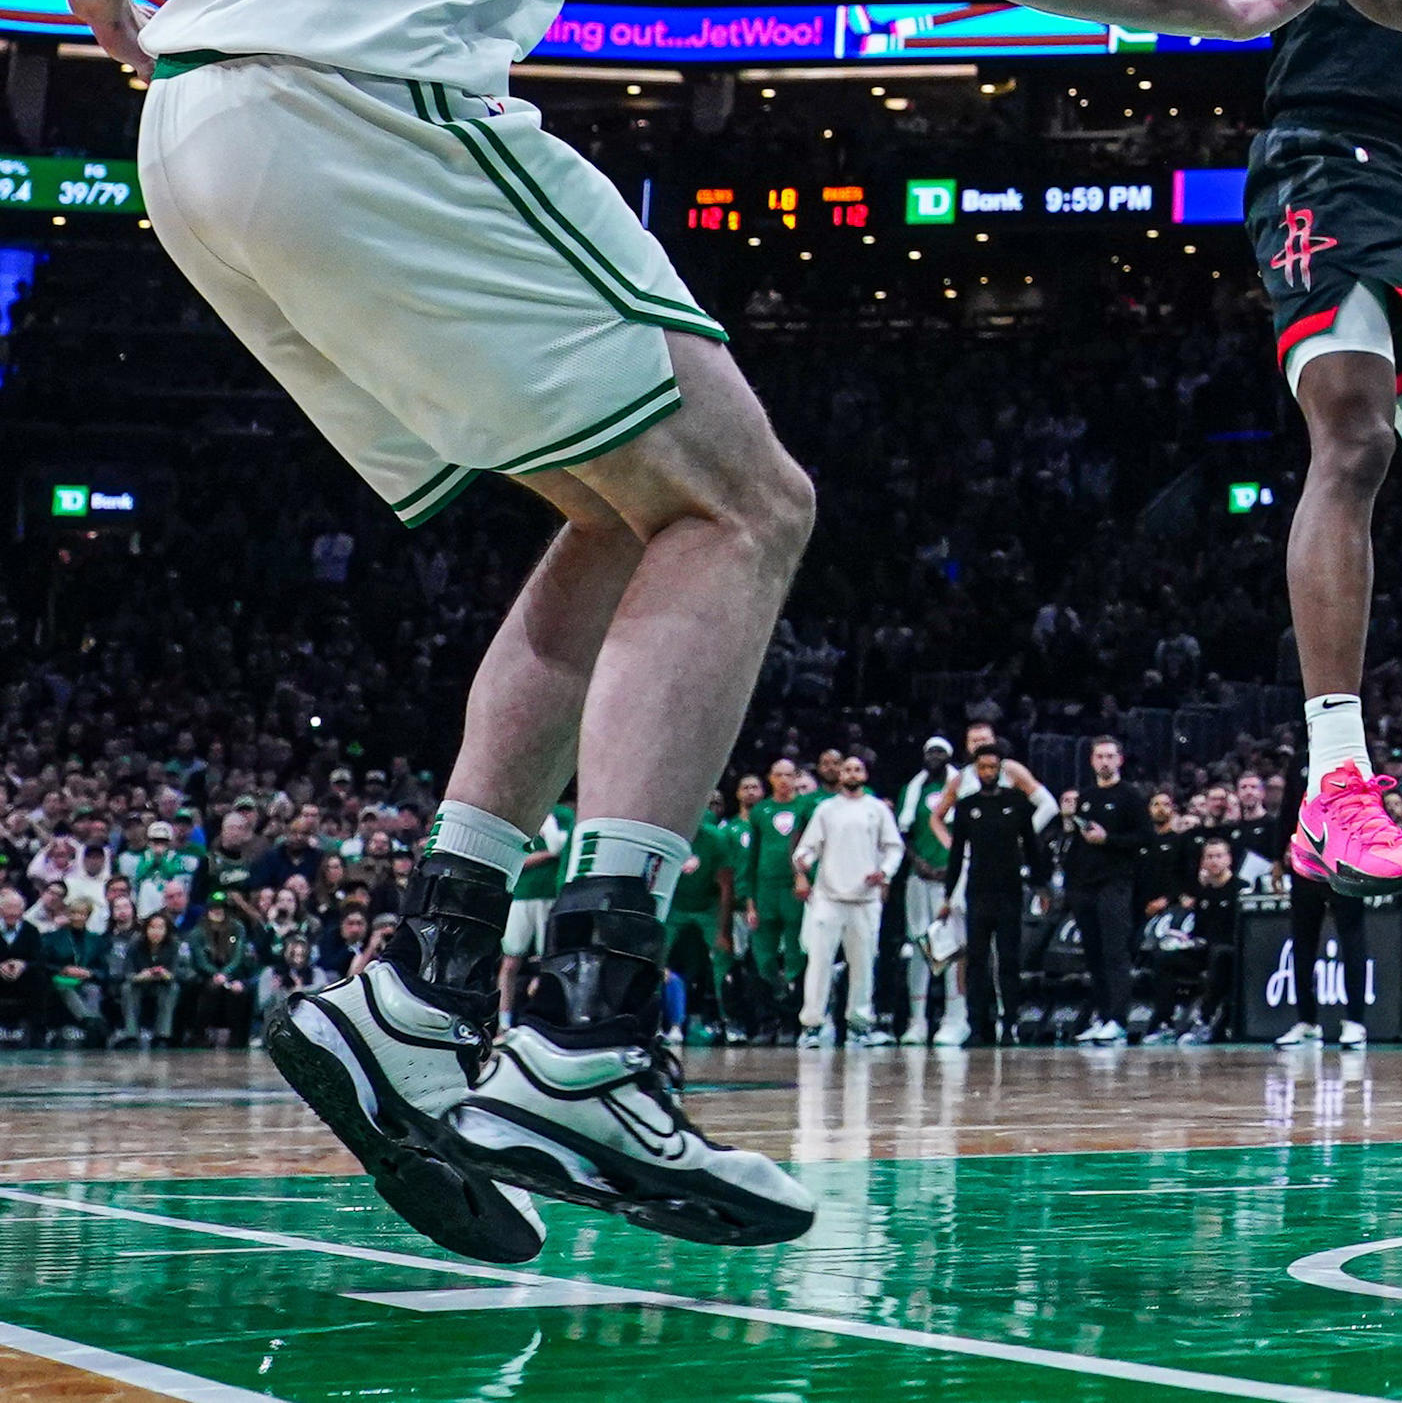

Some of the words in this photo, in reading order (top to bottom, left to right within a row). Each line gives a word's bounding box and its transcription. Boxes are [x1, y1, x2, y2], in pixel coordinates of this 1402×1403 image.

[58, 181, 130, 205] 39/79
[912, 187, 950, 215] TD
[962, 188, 1024, 212] Bank
[1045, 186, 1105, 213] 9:59
[1108, 185, 1152, 211] PM
